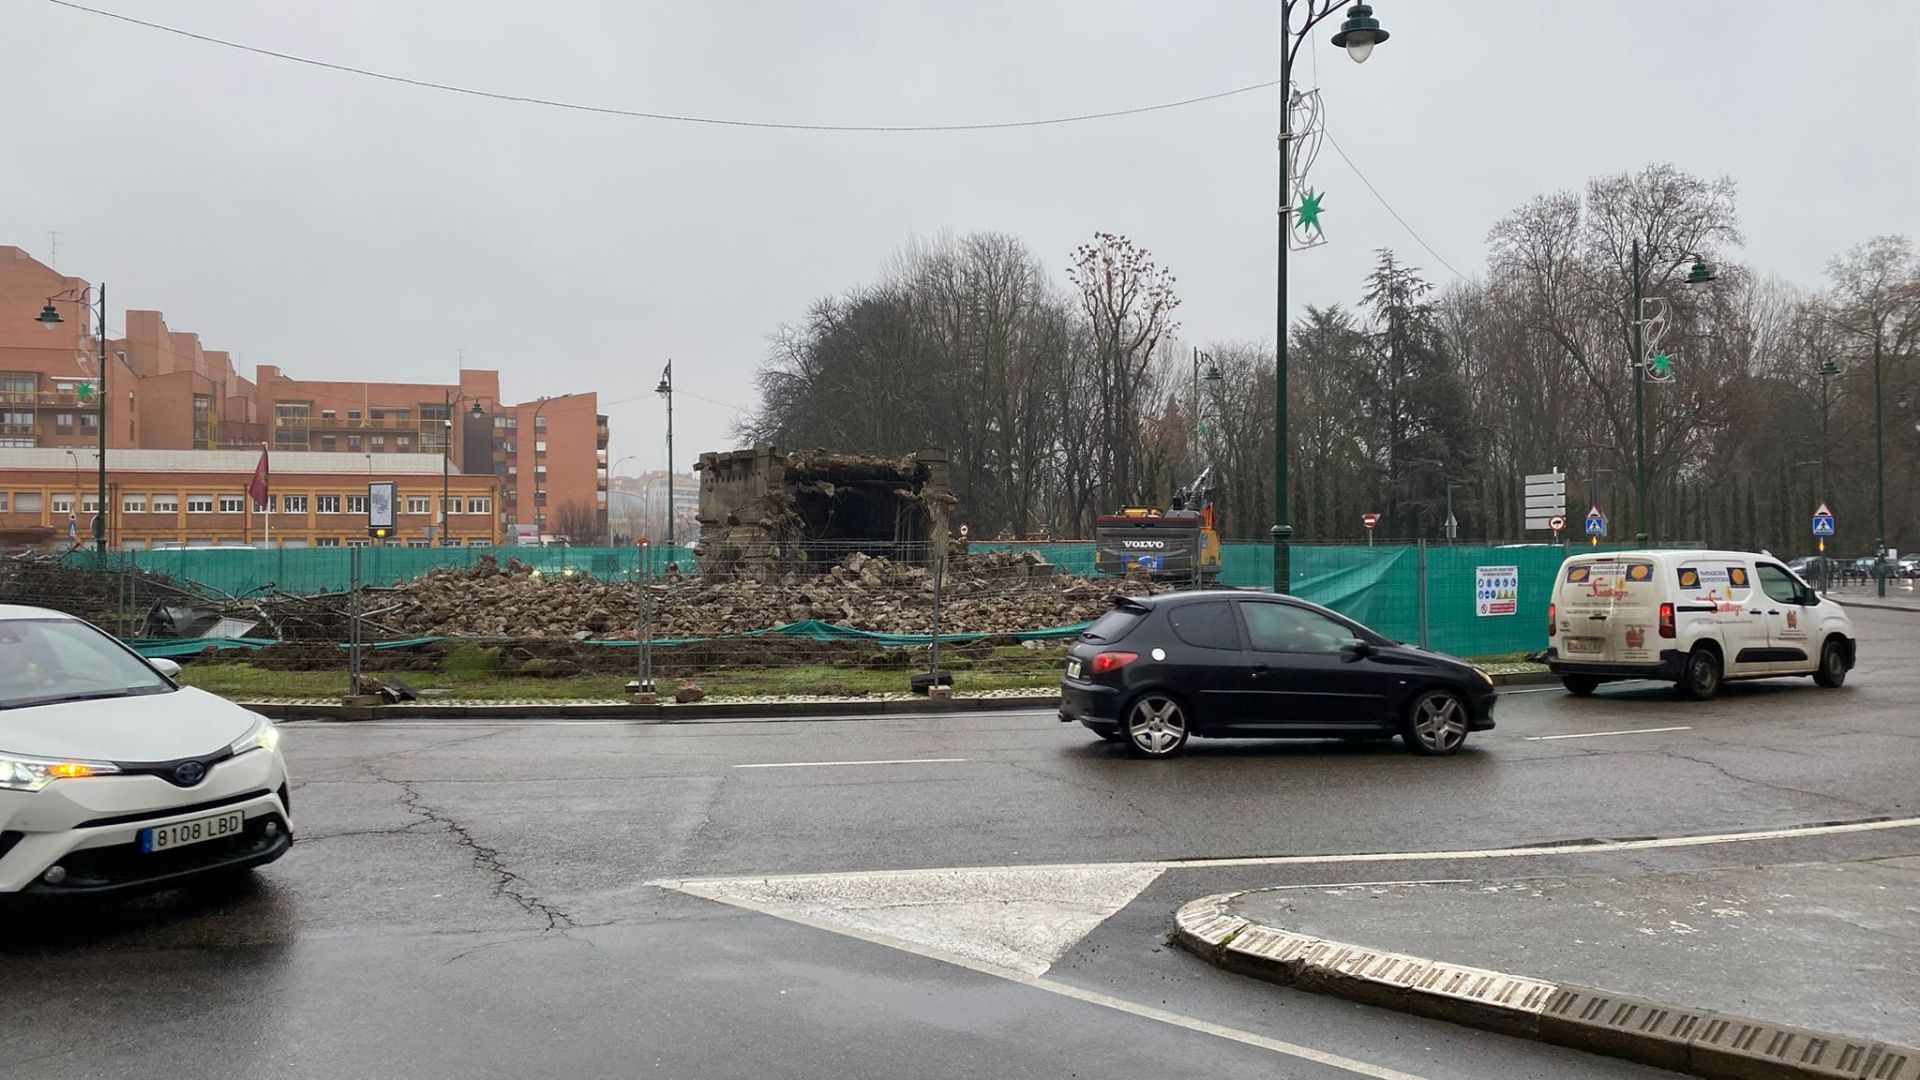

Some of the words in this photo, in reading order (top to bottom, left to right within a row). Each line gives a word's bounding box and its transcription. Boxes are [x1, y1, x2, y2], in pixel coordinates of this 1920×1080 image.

[1122, 540, 1165, 549] VOLVO
[157, 823, 201, 847] 8108
[207, 815, 239, 837] LBD
